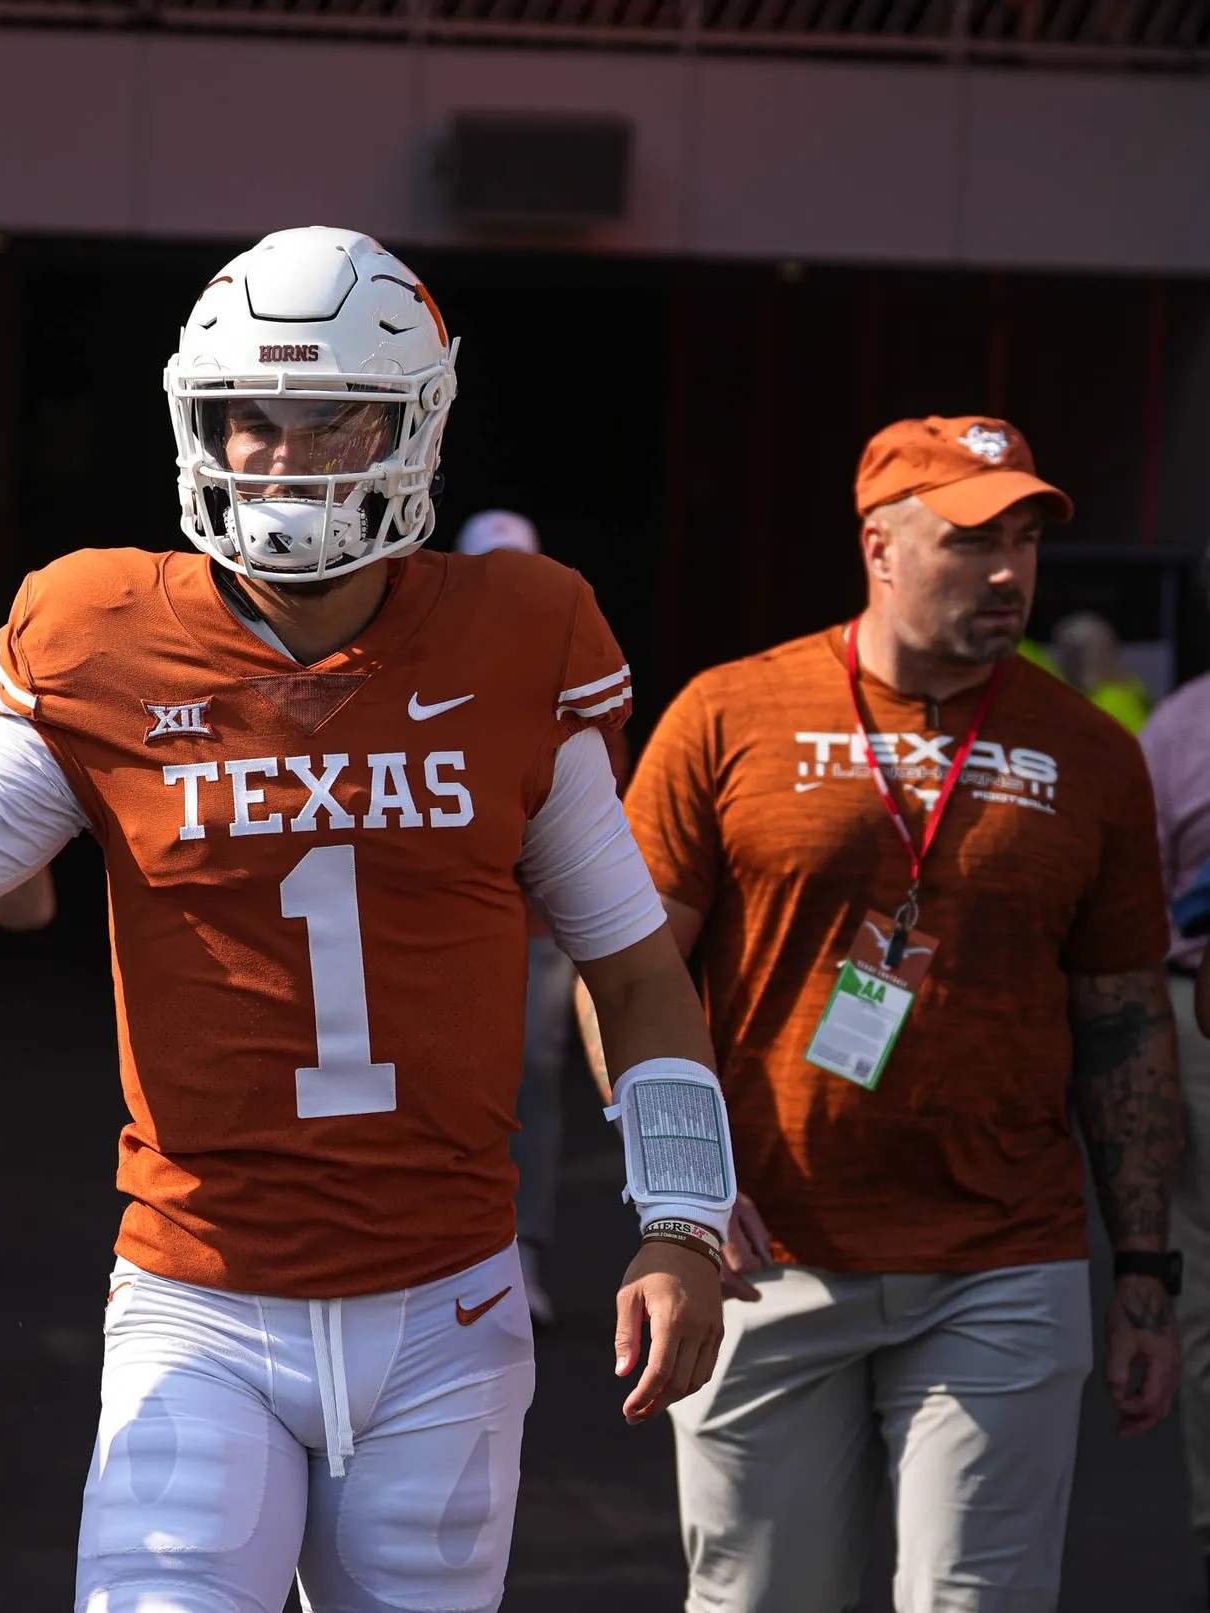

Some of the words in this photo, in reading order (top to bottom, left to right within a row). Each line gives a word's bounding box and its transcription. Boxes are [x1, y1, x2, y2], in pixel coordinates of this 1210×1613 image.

[259, 345, 319, 363] HORNS
[147, 704, 210, 738] XII
[795, 731, 1058, 784] TEXAS
[162, 751, 475, 840] TEXAS
[280, 844, 396, 1119] 1
